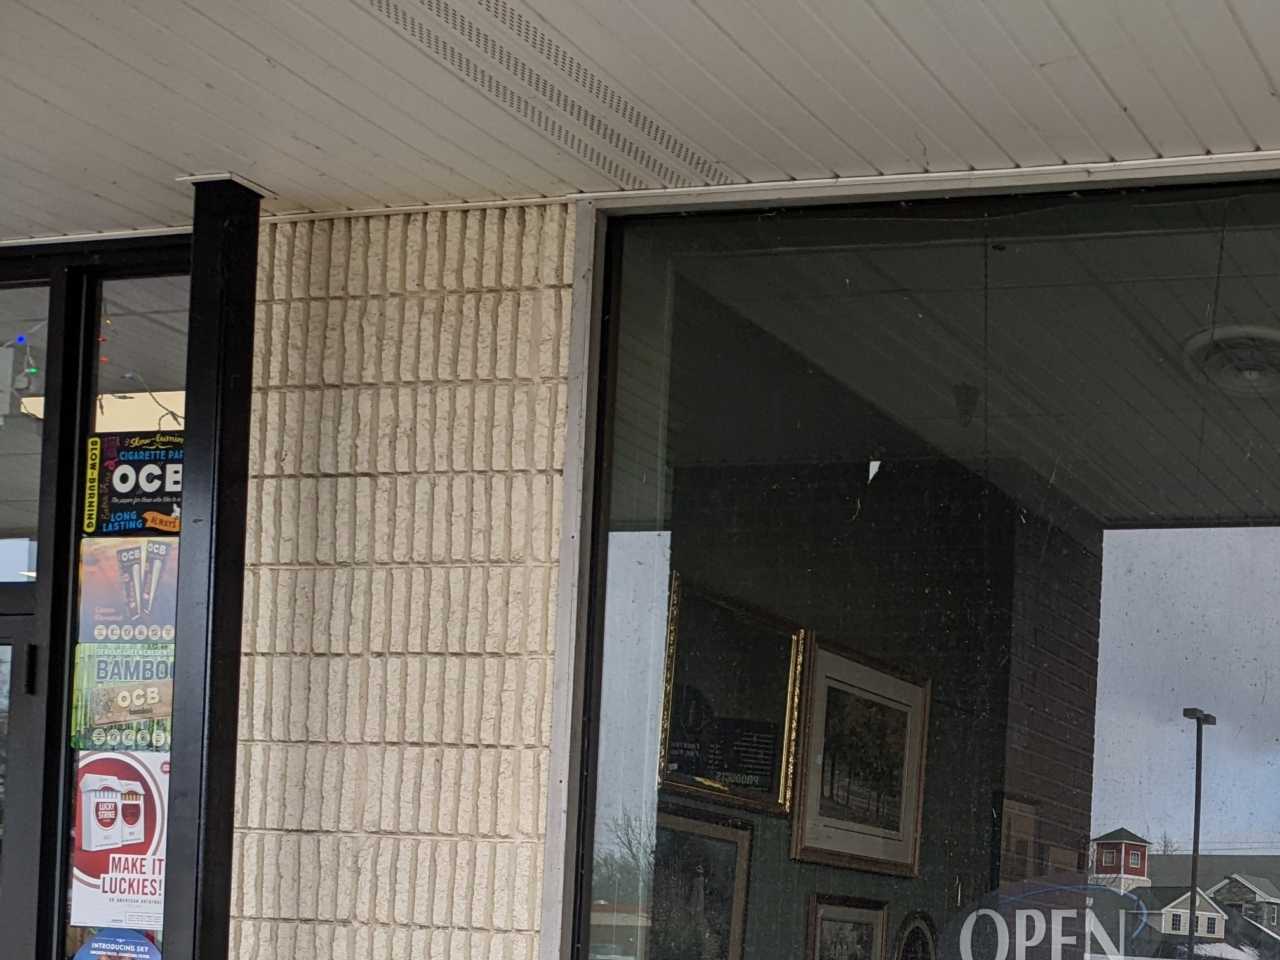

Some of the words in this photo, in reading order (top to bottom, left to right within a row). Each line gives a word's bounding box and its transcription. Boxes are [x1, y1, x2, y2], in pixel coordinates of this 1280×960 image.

[120, 451, 166, 460] CIGARETTE
[112, 464, 183, 493] OCB
[111, 511, 137, 522] LONG
[102, 520, 144, 532] LASTING
[147, 543, 167, 555] OCB
[96, 659, 175, 681] BAMBO
[117, 687, 160, 708] OCB
[111, 856, 147, 875] MAKE
[152, 858, 165, 876] IT
[101, 877, 162, 897] LUCKIES!
[91, 943, 135, 952] INTRODUCING
